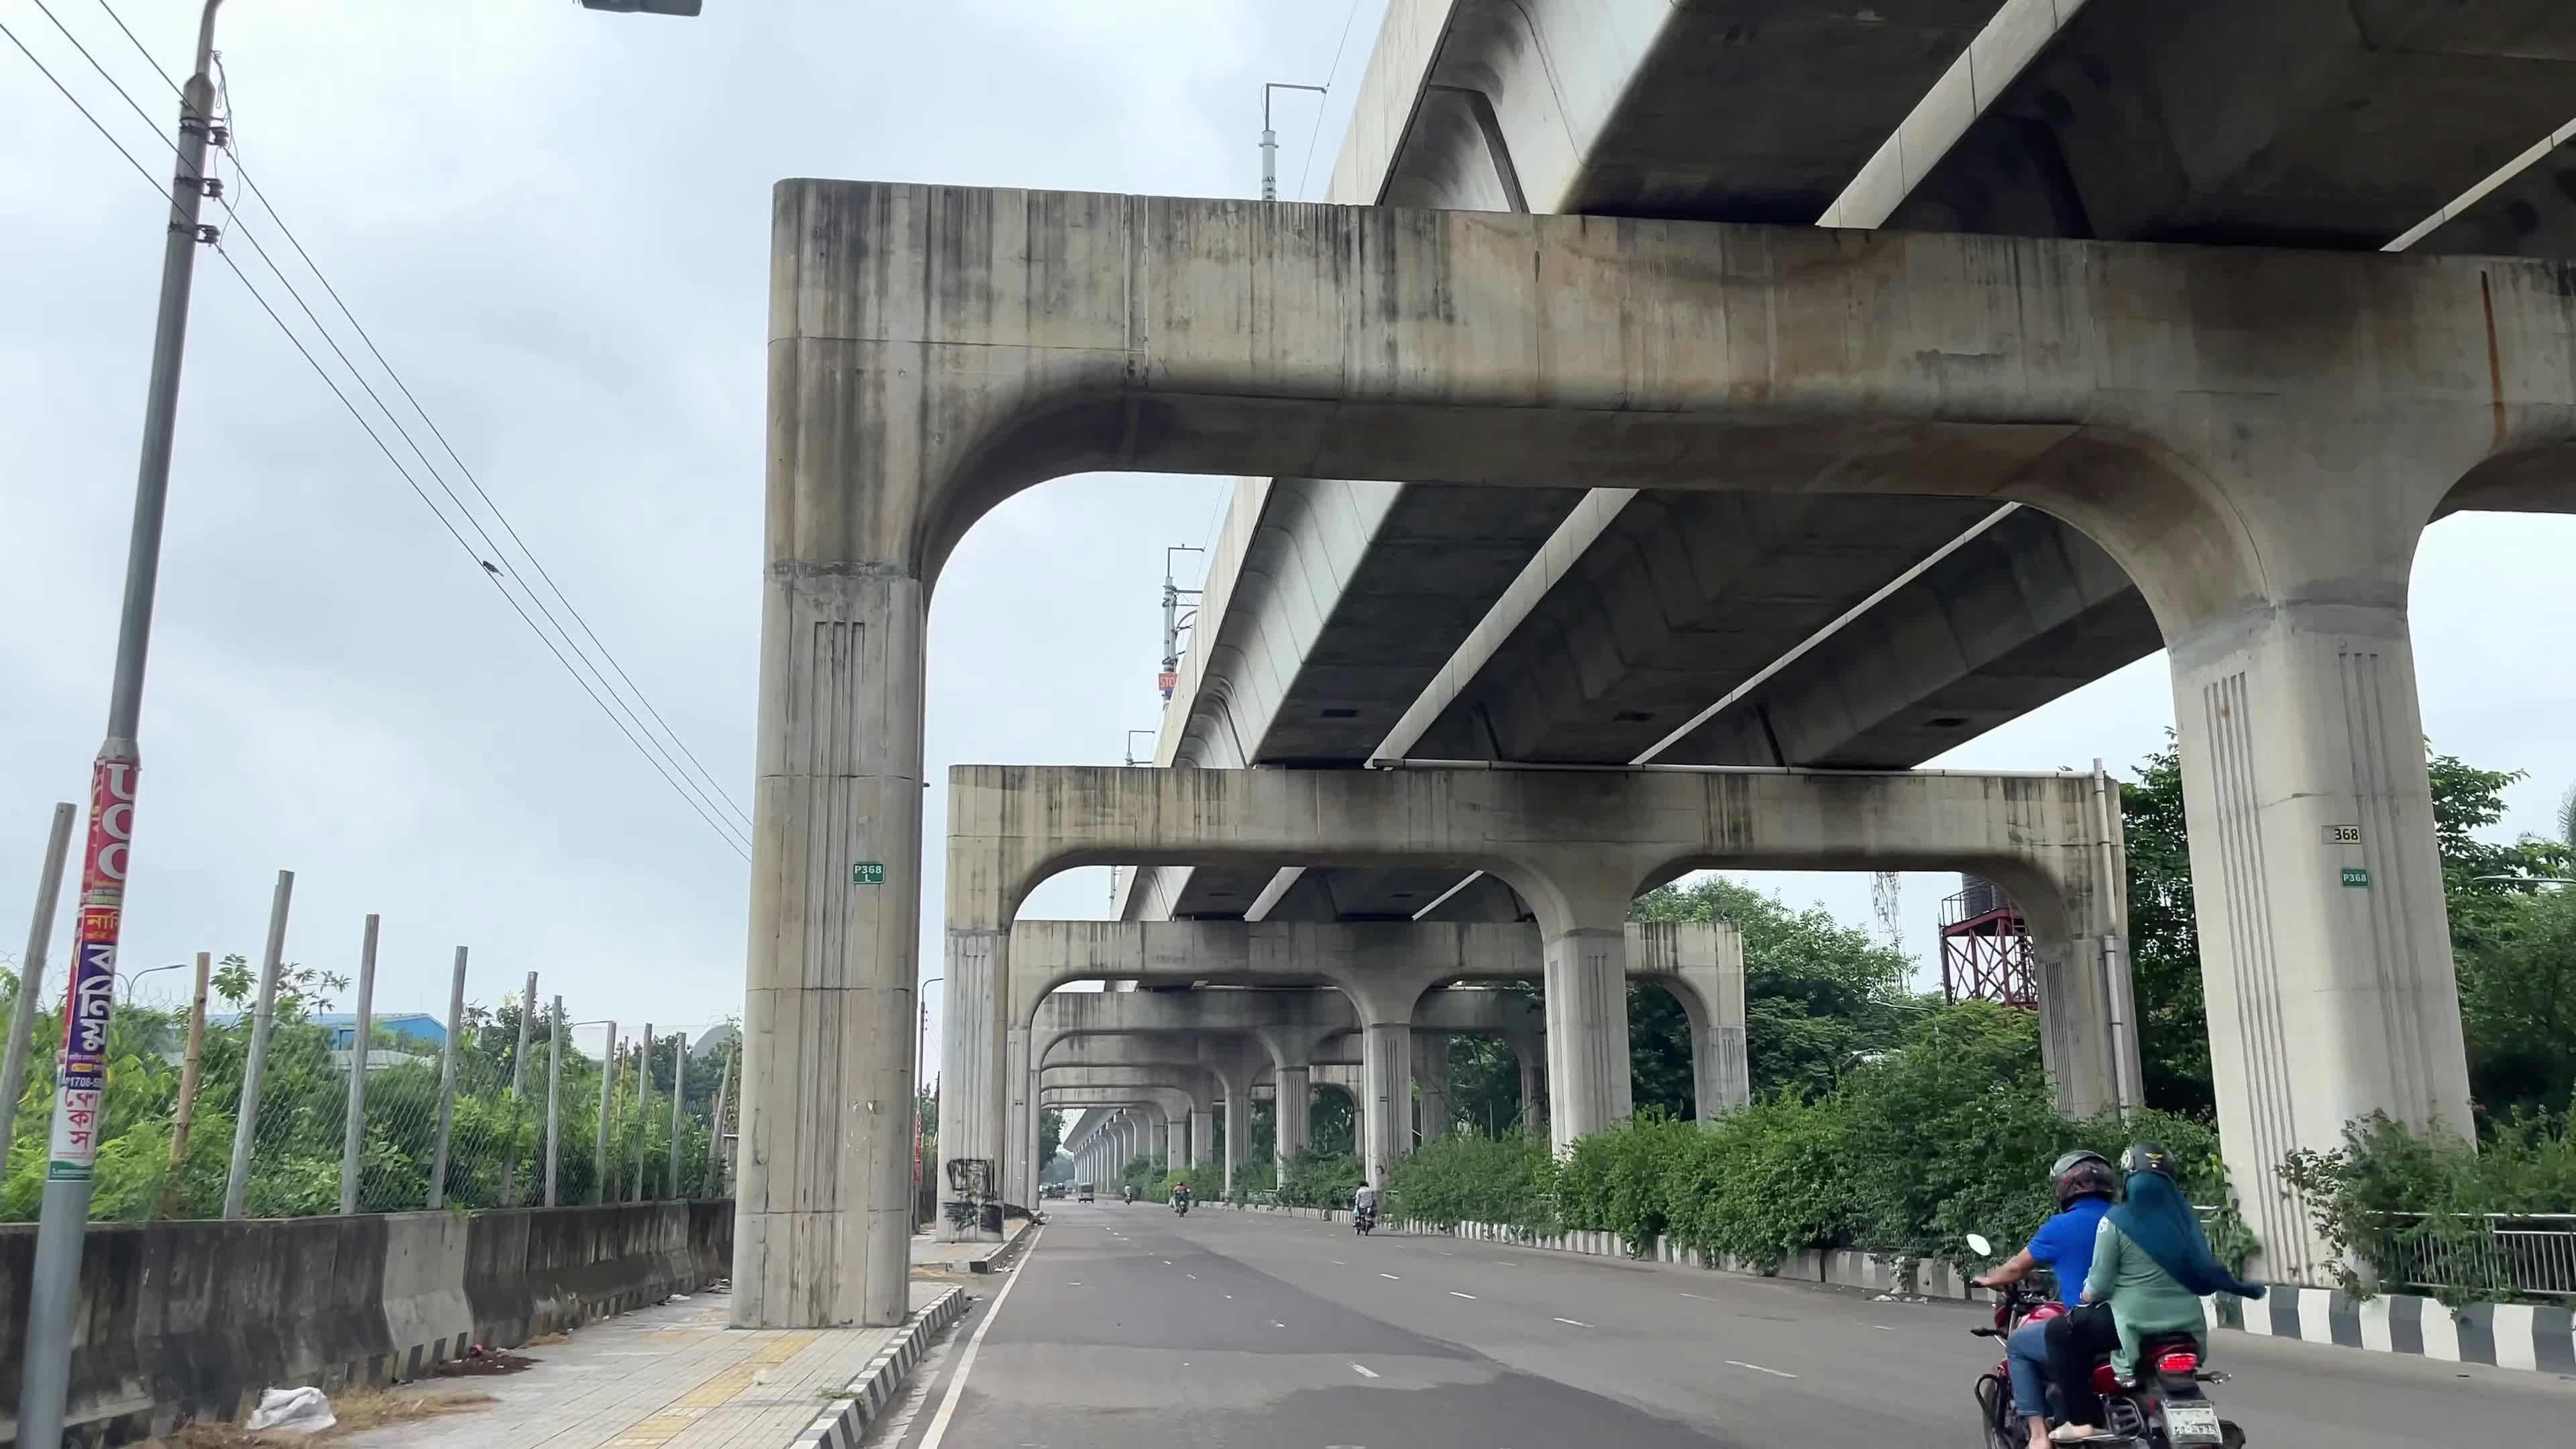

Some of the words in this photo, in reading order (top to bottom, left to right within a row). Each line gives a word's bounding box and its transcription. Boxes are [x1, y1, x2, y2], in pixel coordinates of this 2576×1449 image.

[2334, 828, 2359, 841] 368
[854, 865, 882, 874] P368
[865, 874, 871, 882] L
[2343, 874, 2367, 882] P368
